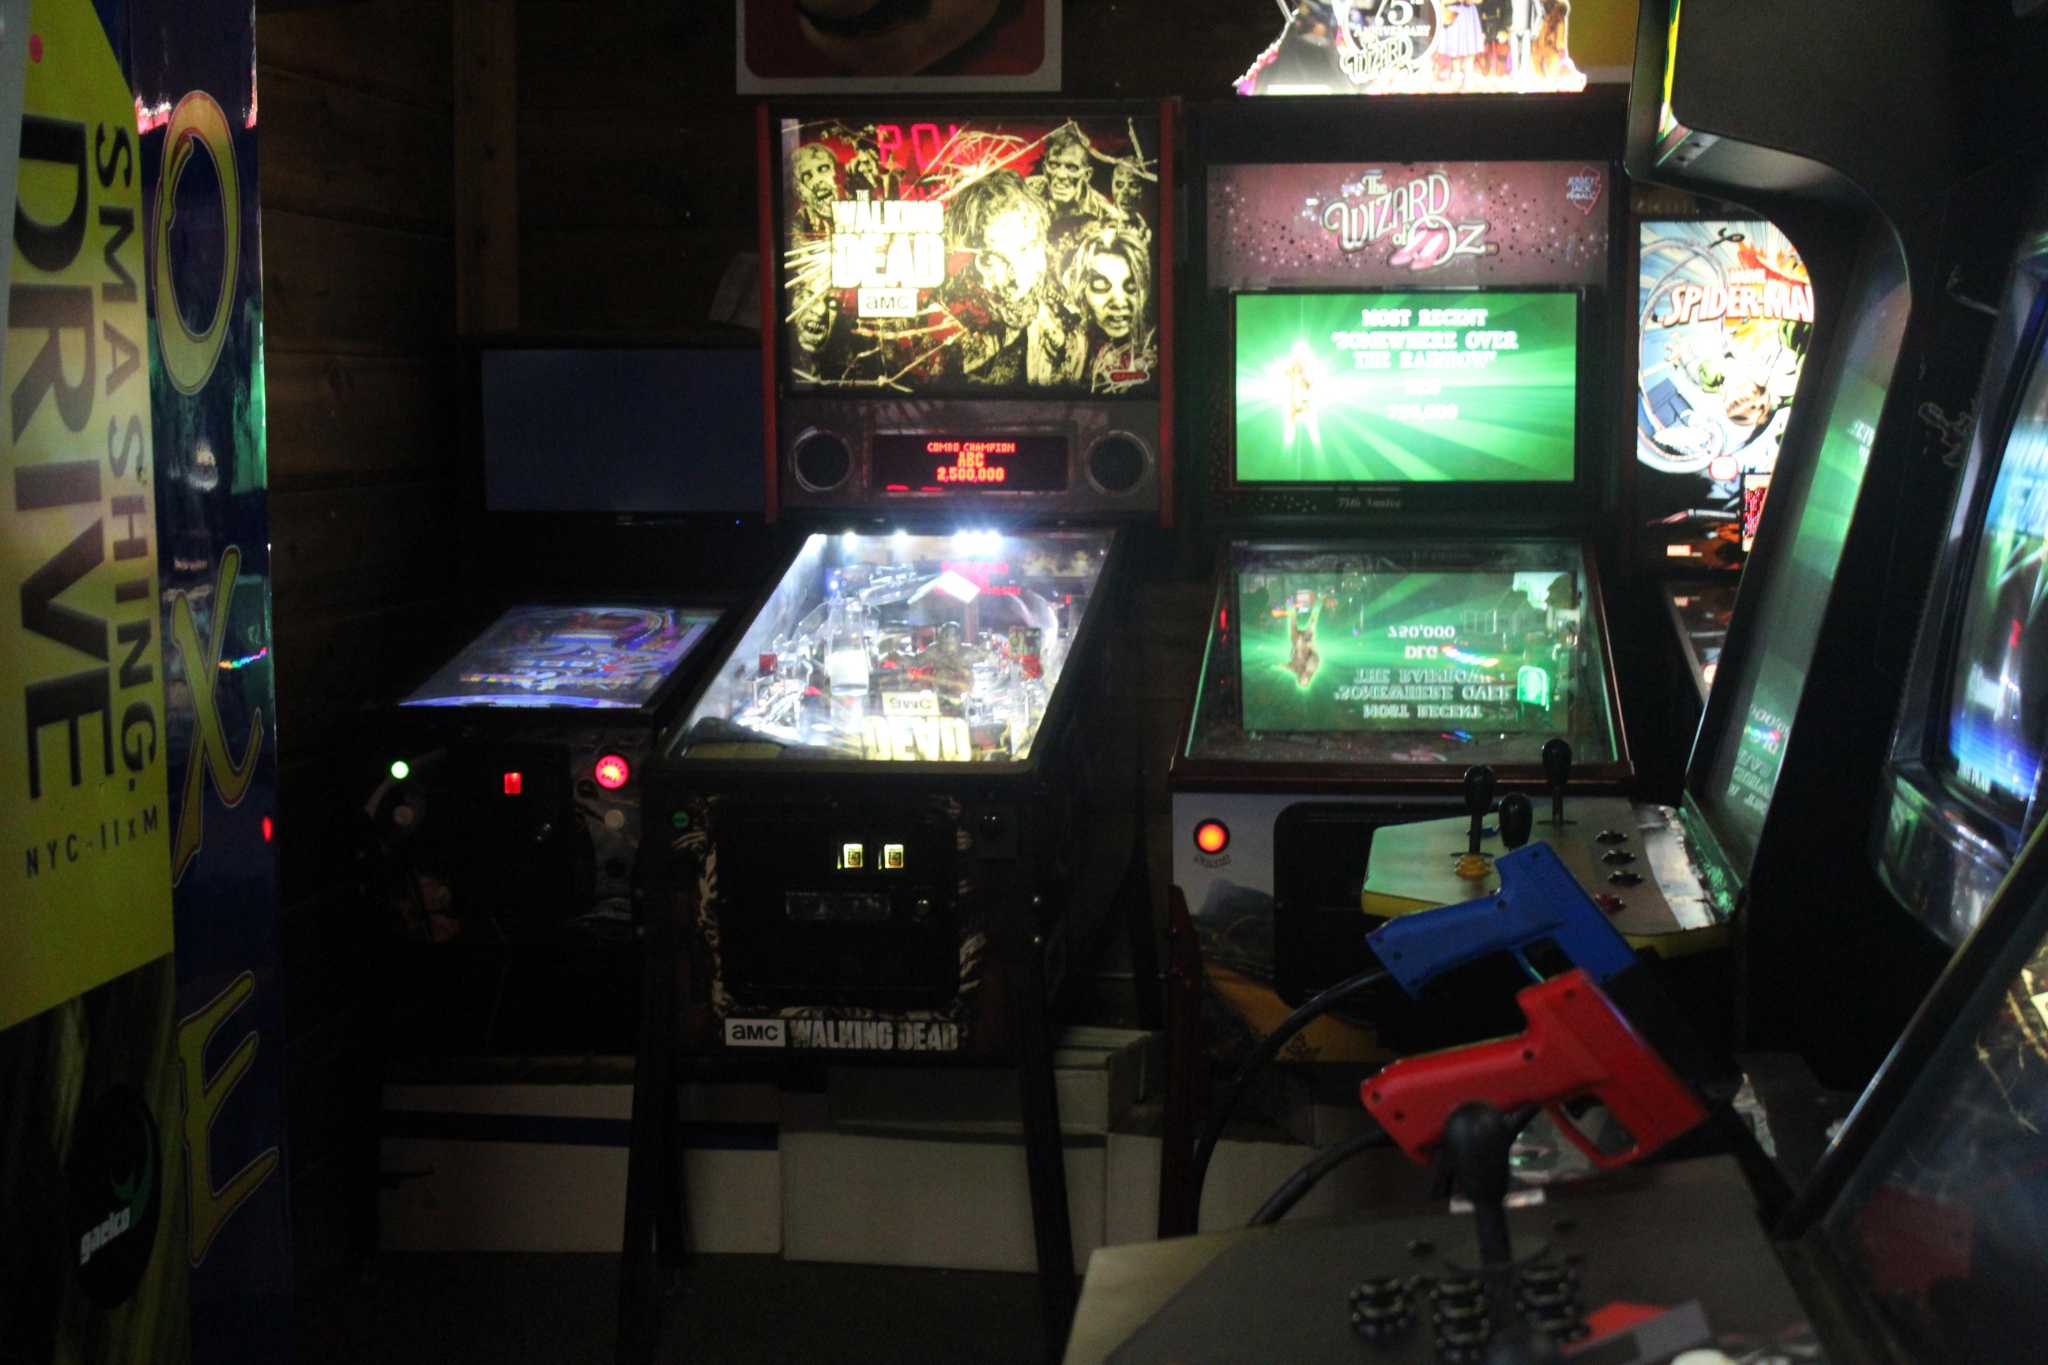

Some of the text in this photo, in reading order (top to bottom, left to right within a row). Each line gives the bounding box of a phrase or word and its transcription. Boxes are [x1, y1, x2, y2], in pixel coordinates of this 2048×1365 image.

[1323, 173, 1450, 251] WIZARD
[831, 232, 946, 288] DEAD
[1662, 282, 1814, 328] SPIDER-MAN
[1362, 309, 1488, 327] MOST RECENT
[1465, 331, 1519, 349] OVER
[1354, 351, 1391, 369] THE
[8, 113, 115, 799] DRIVE
[927, 442, 1015, 453] COMBO CHAMPION
[957, 451, 985, 467] ABC
[936, 467, 1005, 483] 2,500,000
[790, 1019, 893, 1050] WALKING
[899, 1021, 958, 1051] DEAD
